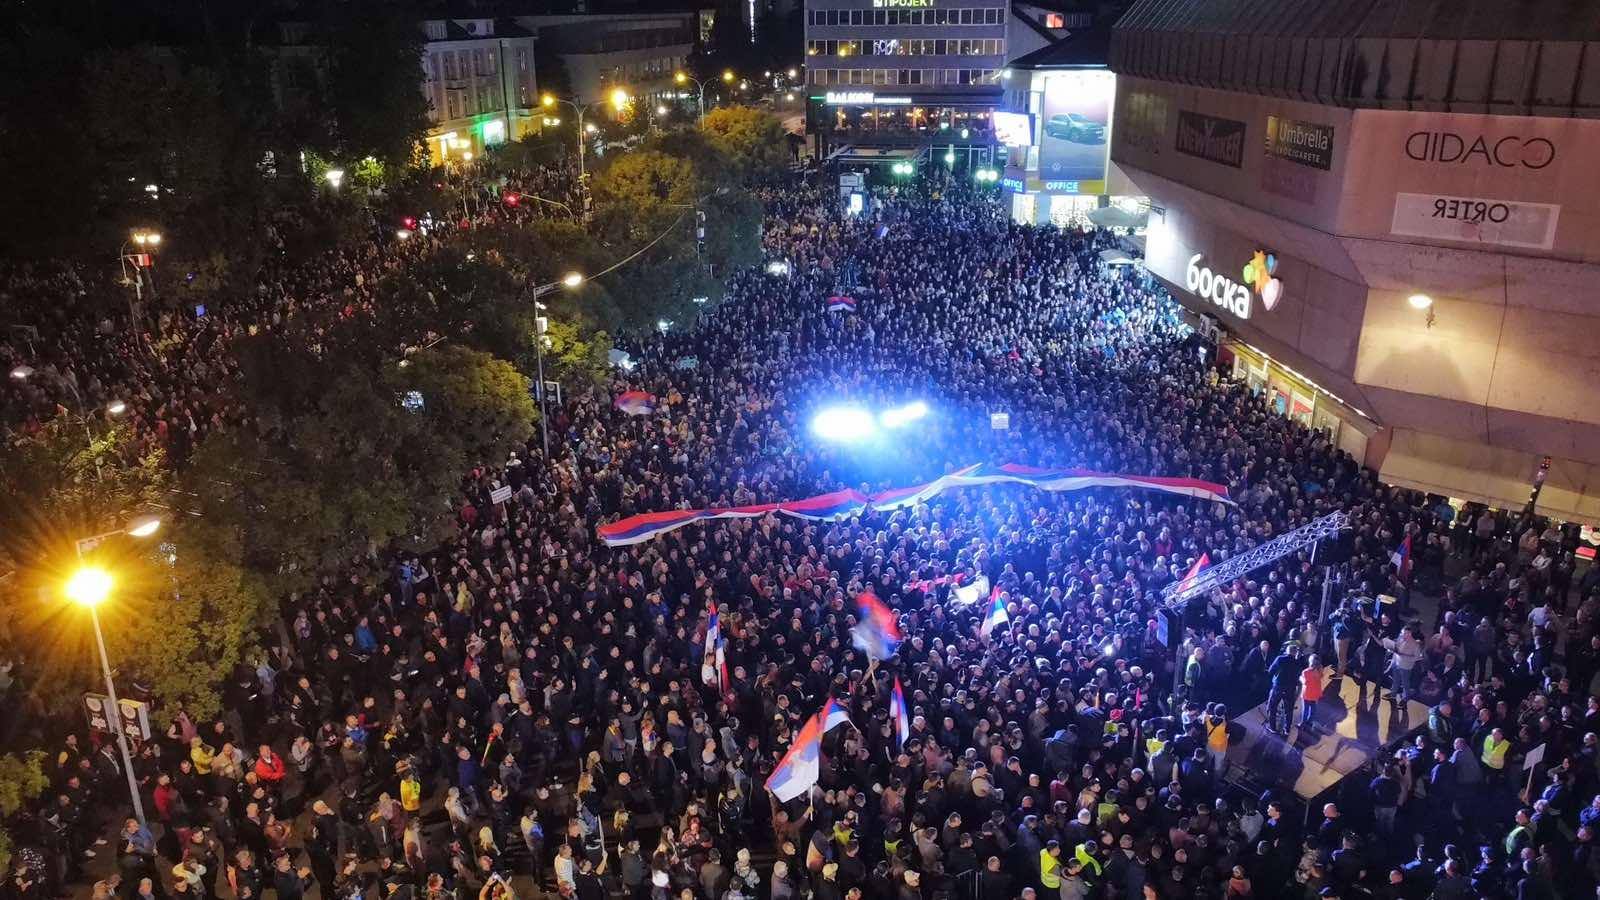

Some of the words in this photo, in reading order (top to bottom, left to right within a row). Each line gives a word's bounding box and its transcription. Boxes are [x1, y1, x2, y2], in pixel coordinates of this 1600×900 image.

[1279, 120, 1329, 151] Umbrella
[1046, 181, 1078, 190] OFFICE
[1186, 253, 1250, 320] боска
